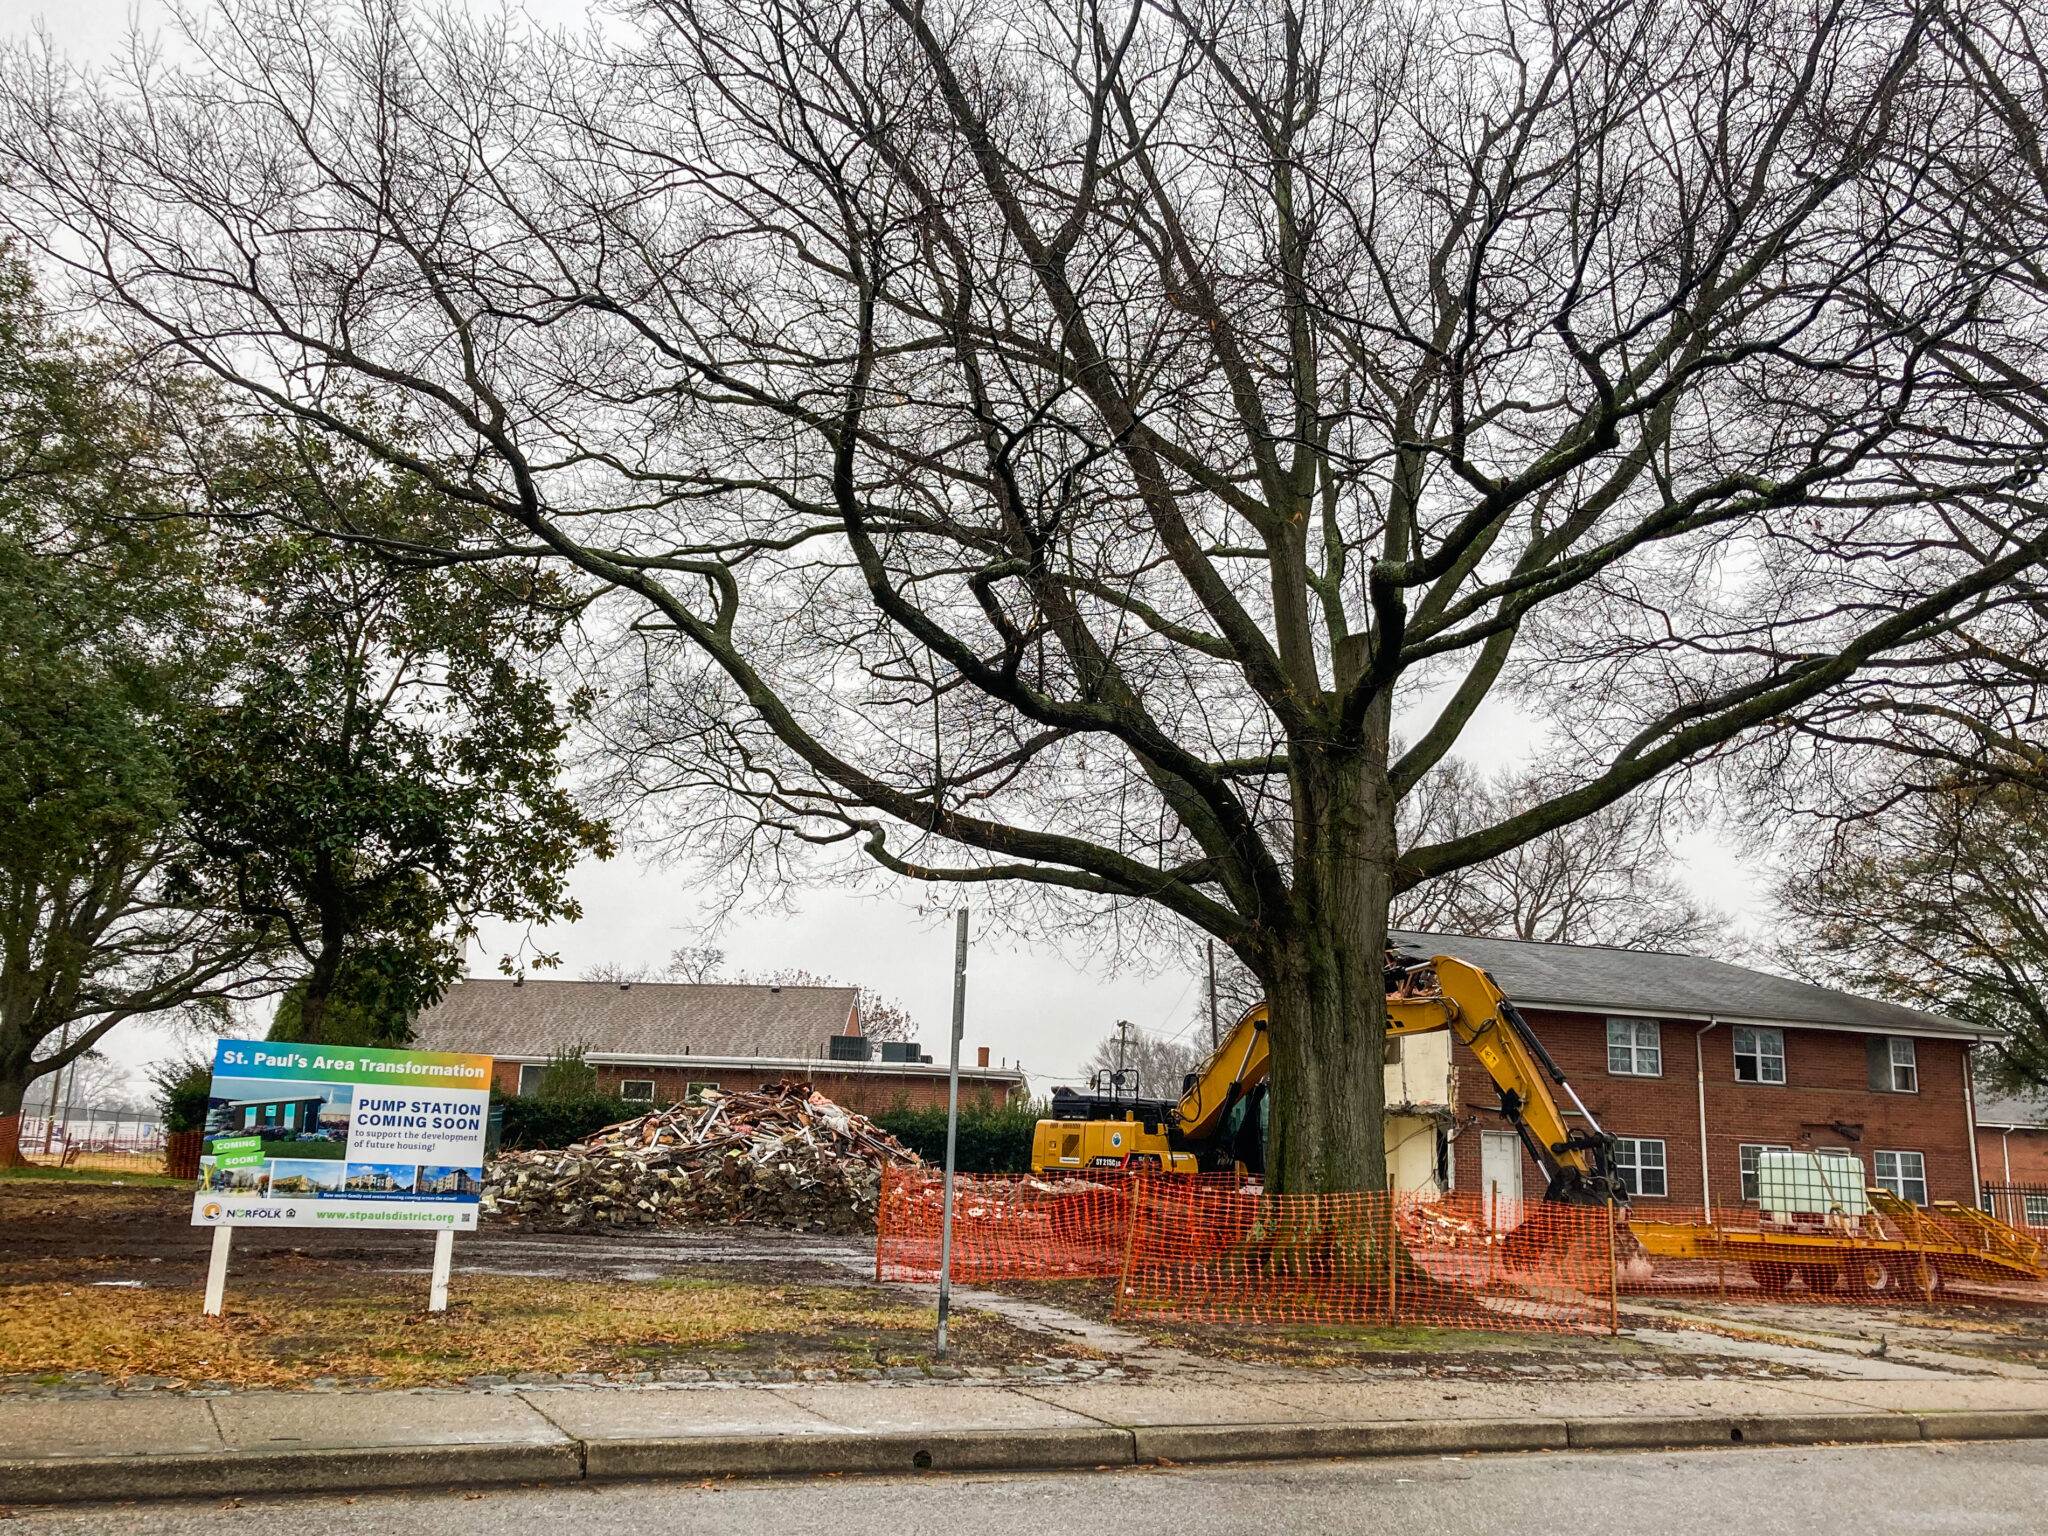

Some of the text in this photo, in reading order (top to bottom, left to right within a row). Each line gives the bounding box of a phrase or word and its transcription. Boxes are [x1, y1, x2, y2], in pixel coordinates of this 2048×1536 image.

[223, 1050, 485, 1078] St. Paul's Area Transformation
[359, 1099, 482, 1116] PUMP STATION
[357, 1113, 480, 1131] COMING SOON
[355, 1129, 478, 1143] to support the development
[216, 1140, 256, 1150] COMING
[353, 1140, 436, 1152] of future housing!
[225, 1155, 258, 1166] SOON!
[226, 1208, 281, 1219] NORFOLK
[316, 1211, 455, 1223] www.stpaulsdistrict.org
